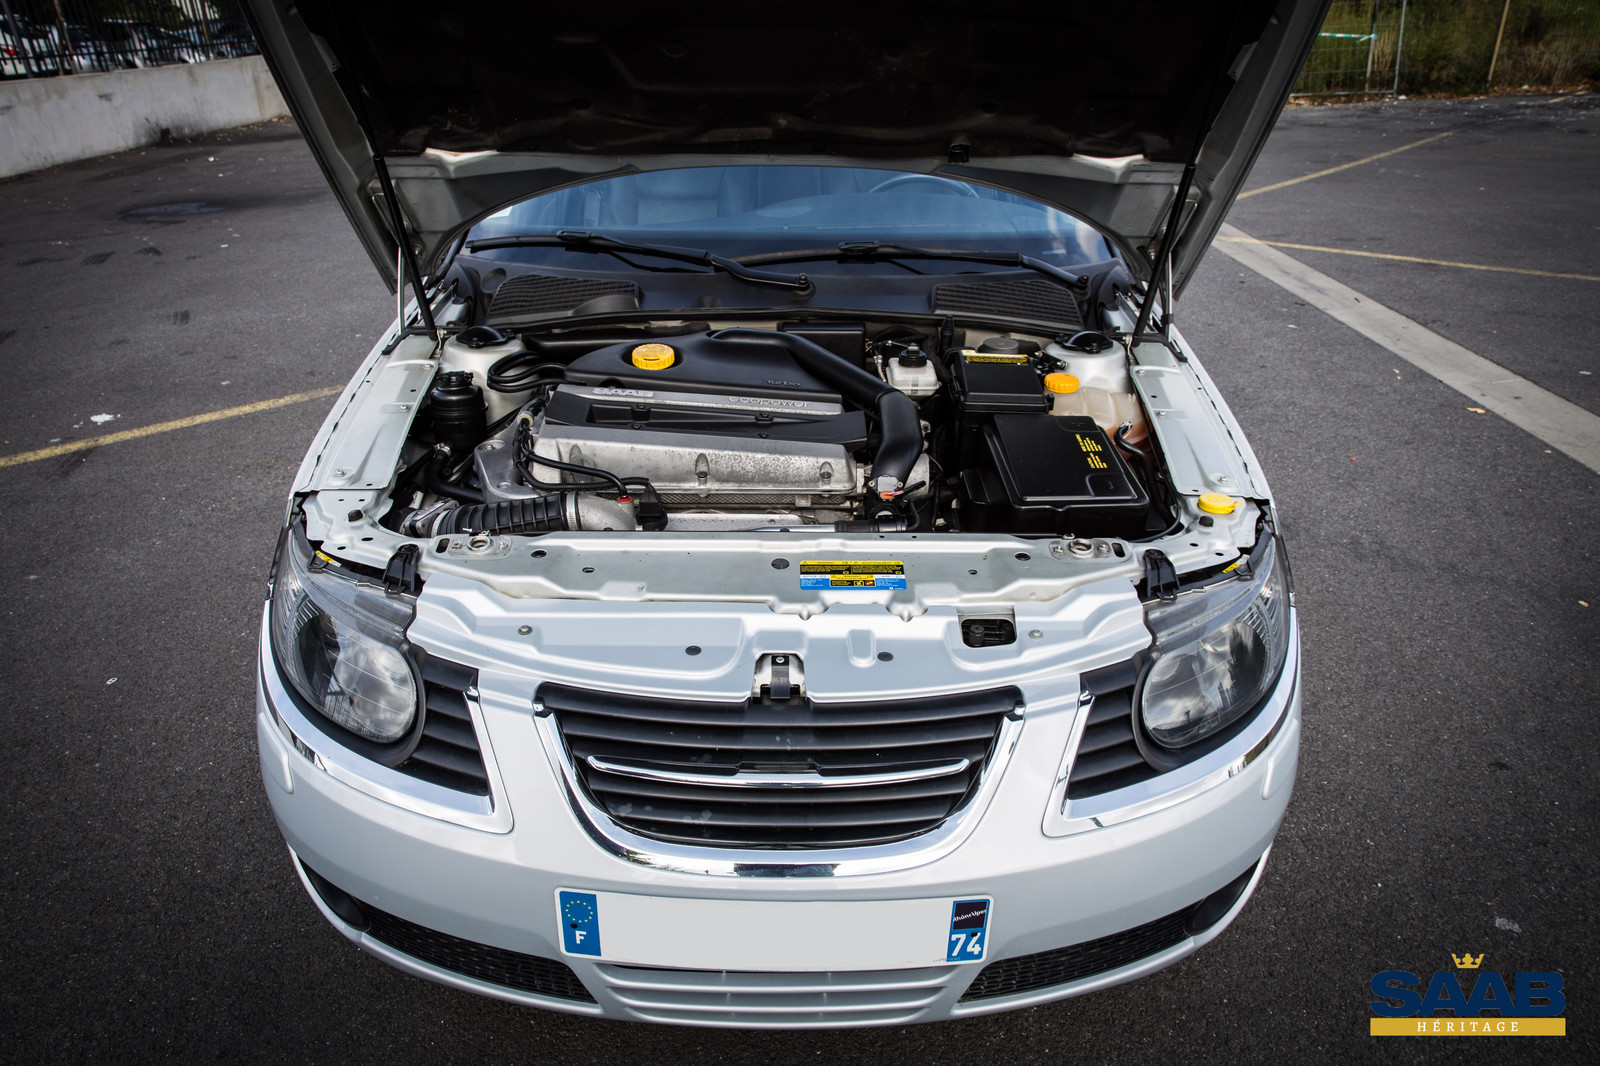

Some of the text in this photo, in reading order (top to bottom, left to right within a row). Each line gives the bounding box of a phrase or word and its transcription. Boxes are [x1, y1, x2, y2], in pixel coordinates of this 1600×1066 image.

[592, 387, 654, 398] SAAB
[575, 930, 587, 944] F
[951, 932, 982, 957] 74
